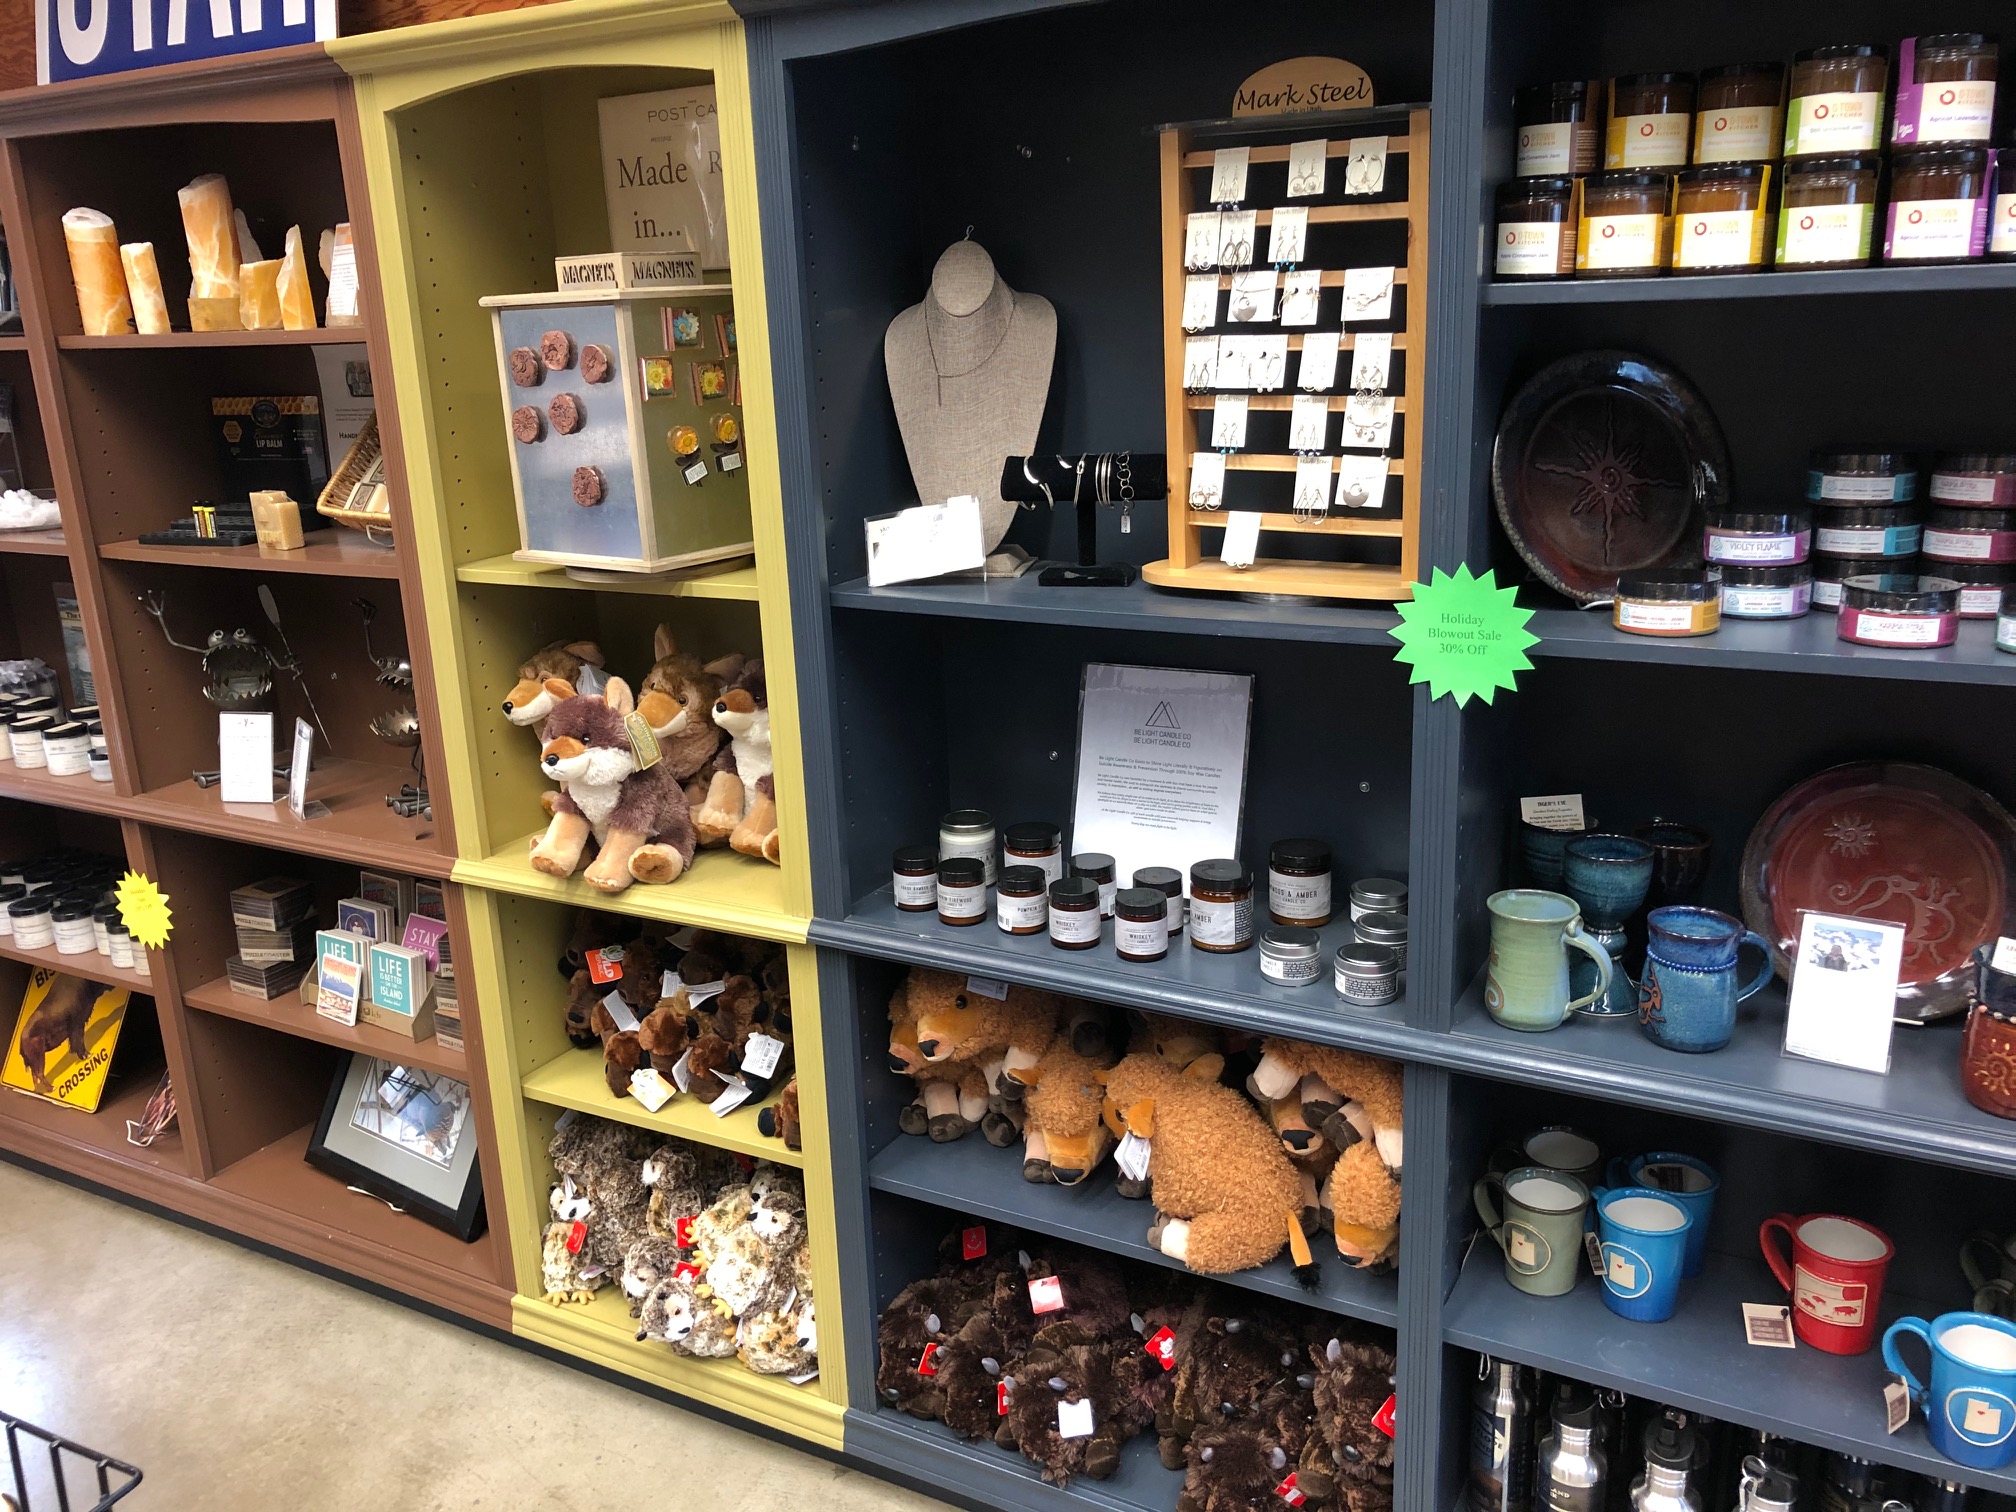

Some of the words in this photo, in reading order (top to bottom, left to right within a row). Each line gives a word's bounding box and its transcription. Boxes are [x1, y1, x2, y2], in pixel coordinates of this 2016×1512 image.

[1237, 84, 1304, 110] Mark
[1307, 78, 1371, 104] Steel
[647, 106, 688, 122] POST
[695, 104, 718, 118] CA
[617, 151, 688, 189] Made
[633, 210, 681, 239] in...
[562, 262, 617, 285] MAGNETS
[631, 259, 697, 281] MAGNETS
[266, 438, 283, 448] BALM
[1729, 542, 1754, 551] VIOLET
[1756, 542, 1781, 551] FLAME
[1441, 613, 1485, 627] Holiday
[1428, 628, 1474, 640] Blowout
[1478, 630, 1502, 641] Sale
[1439, 643, 1464, 655] 30%
[1467, 645, 1488, 655] Off
[637, 716, 658, 757] DESTINATION
[1134, 728, 1141, 736] BE
[1142, 729, 1159, 737] LIGHT
[1159, 730, 1182, 740] CANDLE
[1183, 732, 1191, 740] CO
[1142, 737, 1158, 746] LIGHT
[1158, 739, 1181, 748] CANDLE
[1295, 890, 1318, 899] AMBER
[1056, 919, 1076, 927] WHISKEY
[1194, 914, 1212, 923] AMBER
[410, 927, 439, 947] STAY
[324, 940, 347, 959] LIFE
[378, 956, 402, 977] LIFE
[384, 974, 402, 985] BETTER
[380, 986, 403, 1000] ISLAND
[59, 1048, 109, 1098] CROSSING
